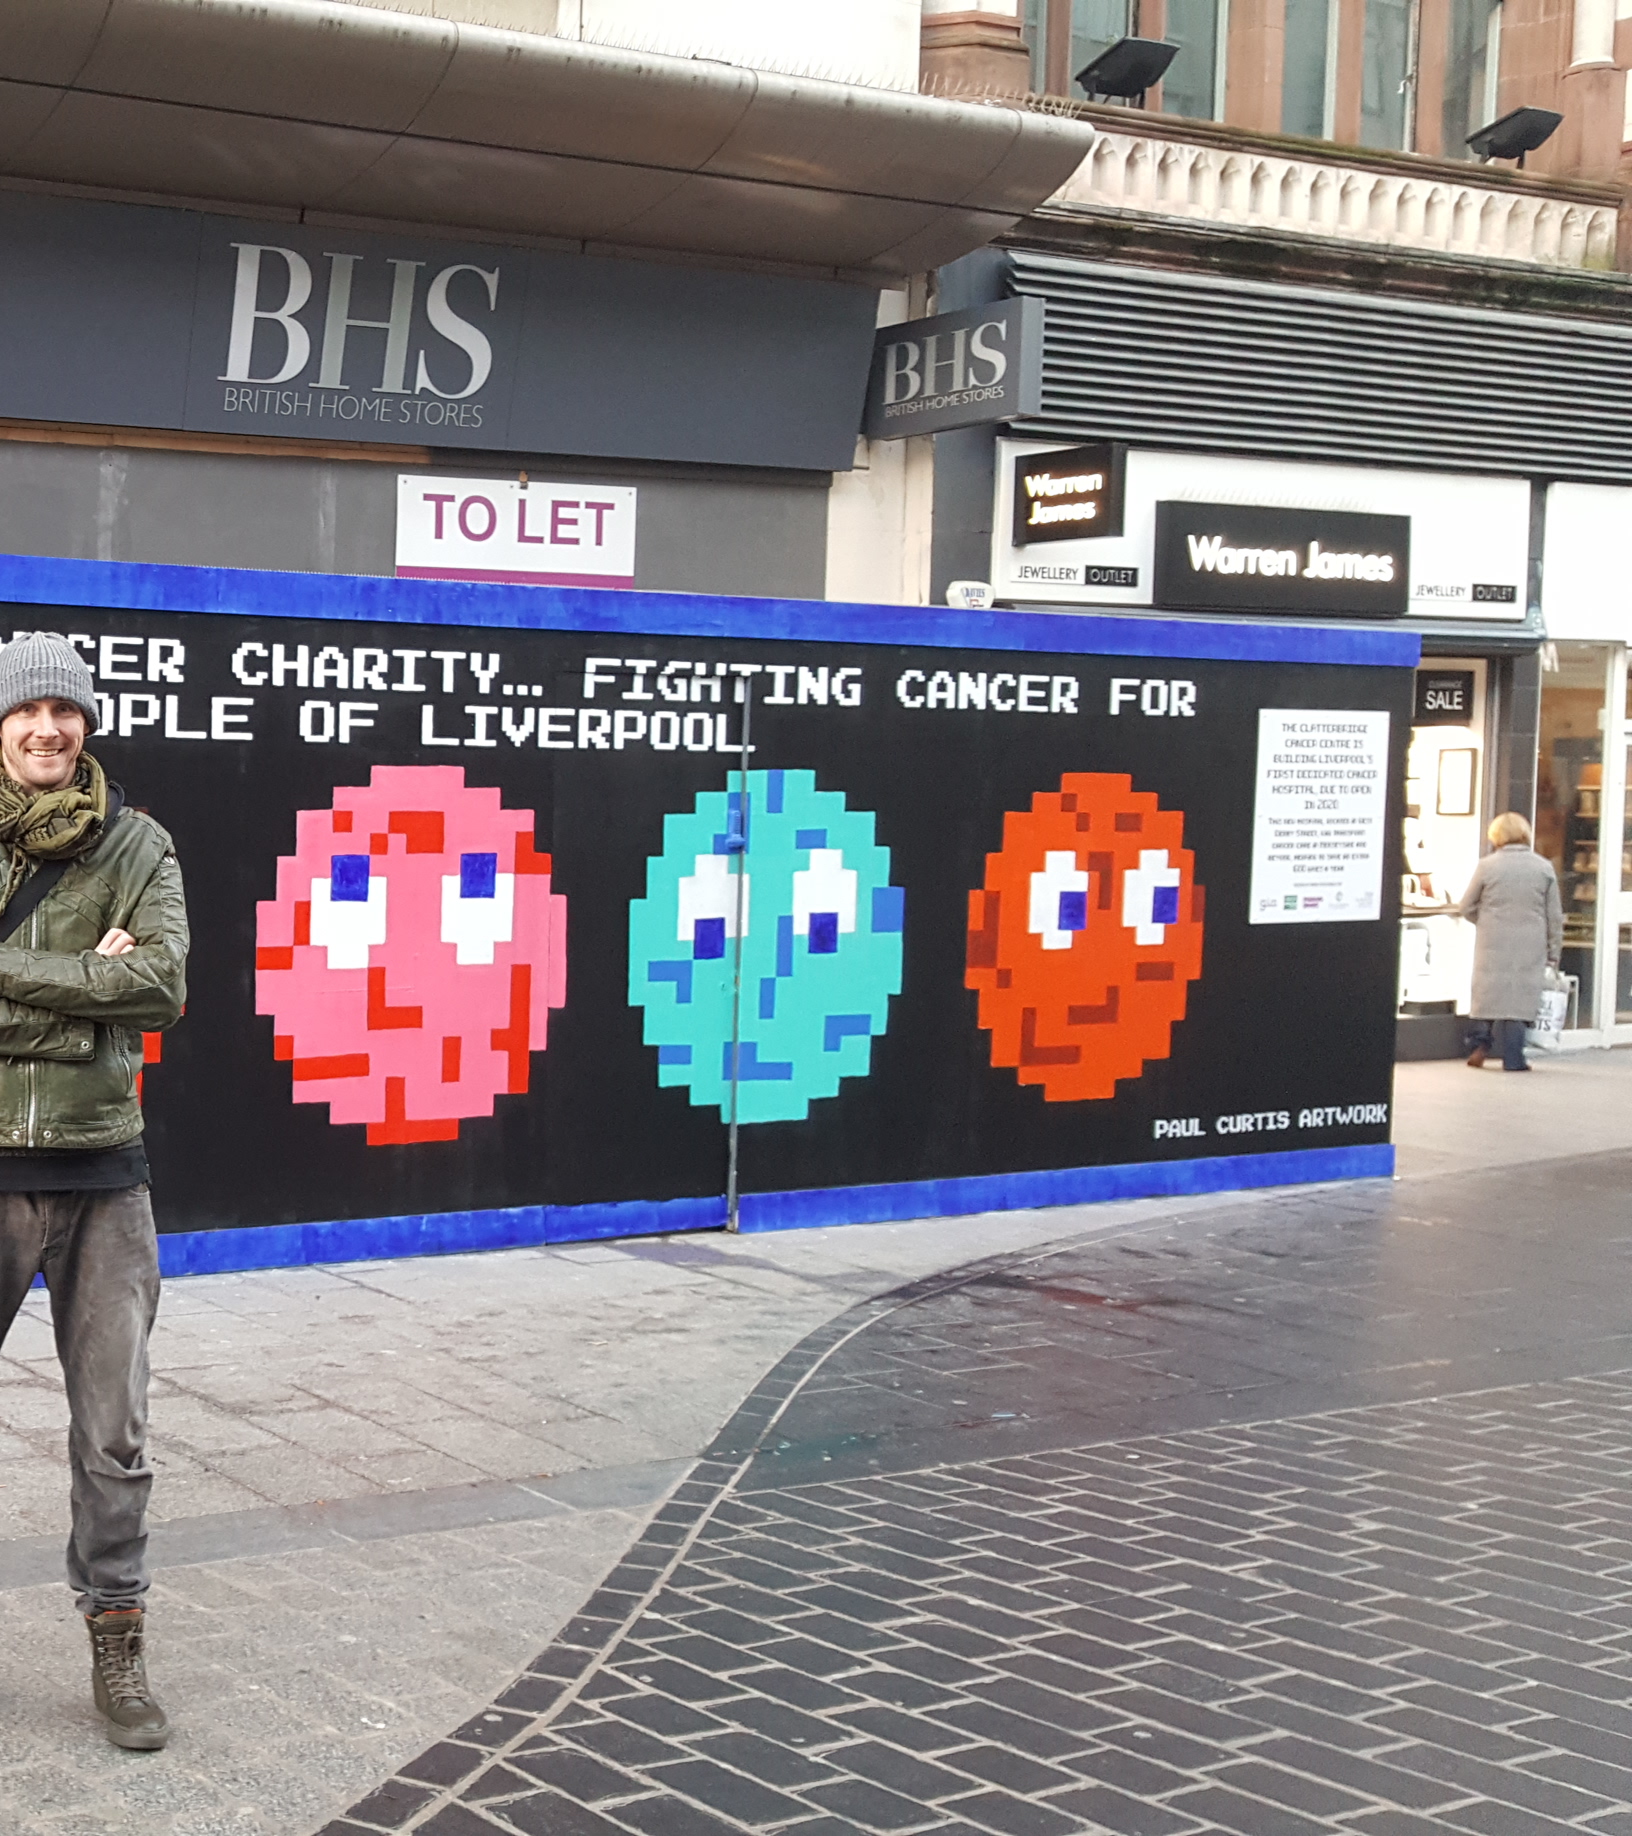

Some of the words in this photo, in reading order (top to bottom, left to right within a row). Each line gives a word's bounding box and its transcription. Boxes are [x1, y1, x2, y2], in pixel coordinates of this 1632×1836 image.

[217, 242, 500, 399] BHS
[880, 319, 1008, 405] BHS
[223, 387, 313, 417] BRITISH
[319, 394, 394, 423] HOME
[398, 400, 484, 428] STORES
[885, 401, 924, 418] BRITISH
[925, 394, 961, 411] HOME
[962, 385, 1005, 404] STORES
[1024, 473, 1103, 497] Warren
[423, 492, 497, 542] TO
[517, 498, 616, 546] LET
[1028, 501, 1096, 525] James
[1187, 534, 1298, 577] Warren
[1302, 540, 1395, 583] James
[1017, 565, 1079, 580] JEWELLERY
[1089, 568, 1134, 583] OUTLET
[1415, 584, 1466, 597] JEWELLERY
[1475, 585, 1513, 600] OUTLET
[231, 642, 543, 697] CHARITY...
[583, 657, 862, 706] FIGHTING
[896, 669, 1079, 714] CANCER
[1109, 678, 1197, 717] FOR
[1425, 690, 1464, 710] SALE
[299, 700, 379, 744] OF
[421, 704, 756, 753] LIVERPOOL
[1282, 723, 1298, 733] THE
[1299, 723, 1369, 734] CLATTERBRIDGE
[1284, 738, 1317, 749] CANCER
[1319, 739, 1351, 749] CENTRE
[1353, 739, 1364, 749] IS
[1273, 754, 1317, 764] BUILDING
[1267, 769, 1294, 779] FIRST
[1296, 769, 1345, 779] DEDICATED
[1346, 769, 1378, 779] CANCER
[1319, 785, 1336, 795] DUE
[1338, 785, 1349, 795] TO
[1350, 785, 1372, 795] OPEN
[1304, 800, 1315, 810] IN
[1154, 1118, 1206, 1140] PAUL
[1216, 1111, 1291, 1135] CURTIS
[1299, 1103, 1388, 1129] ARTWORK
